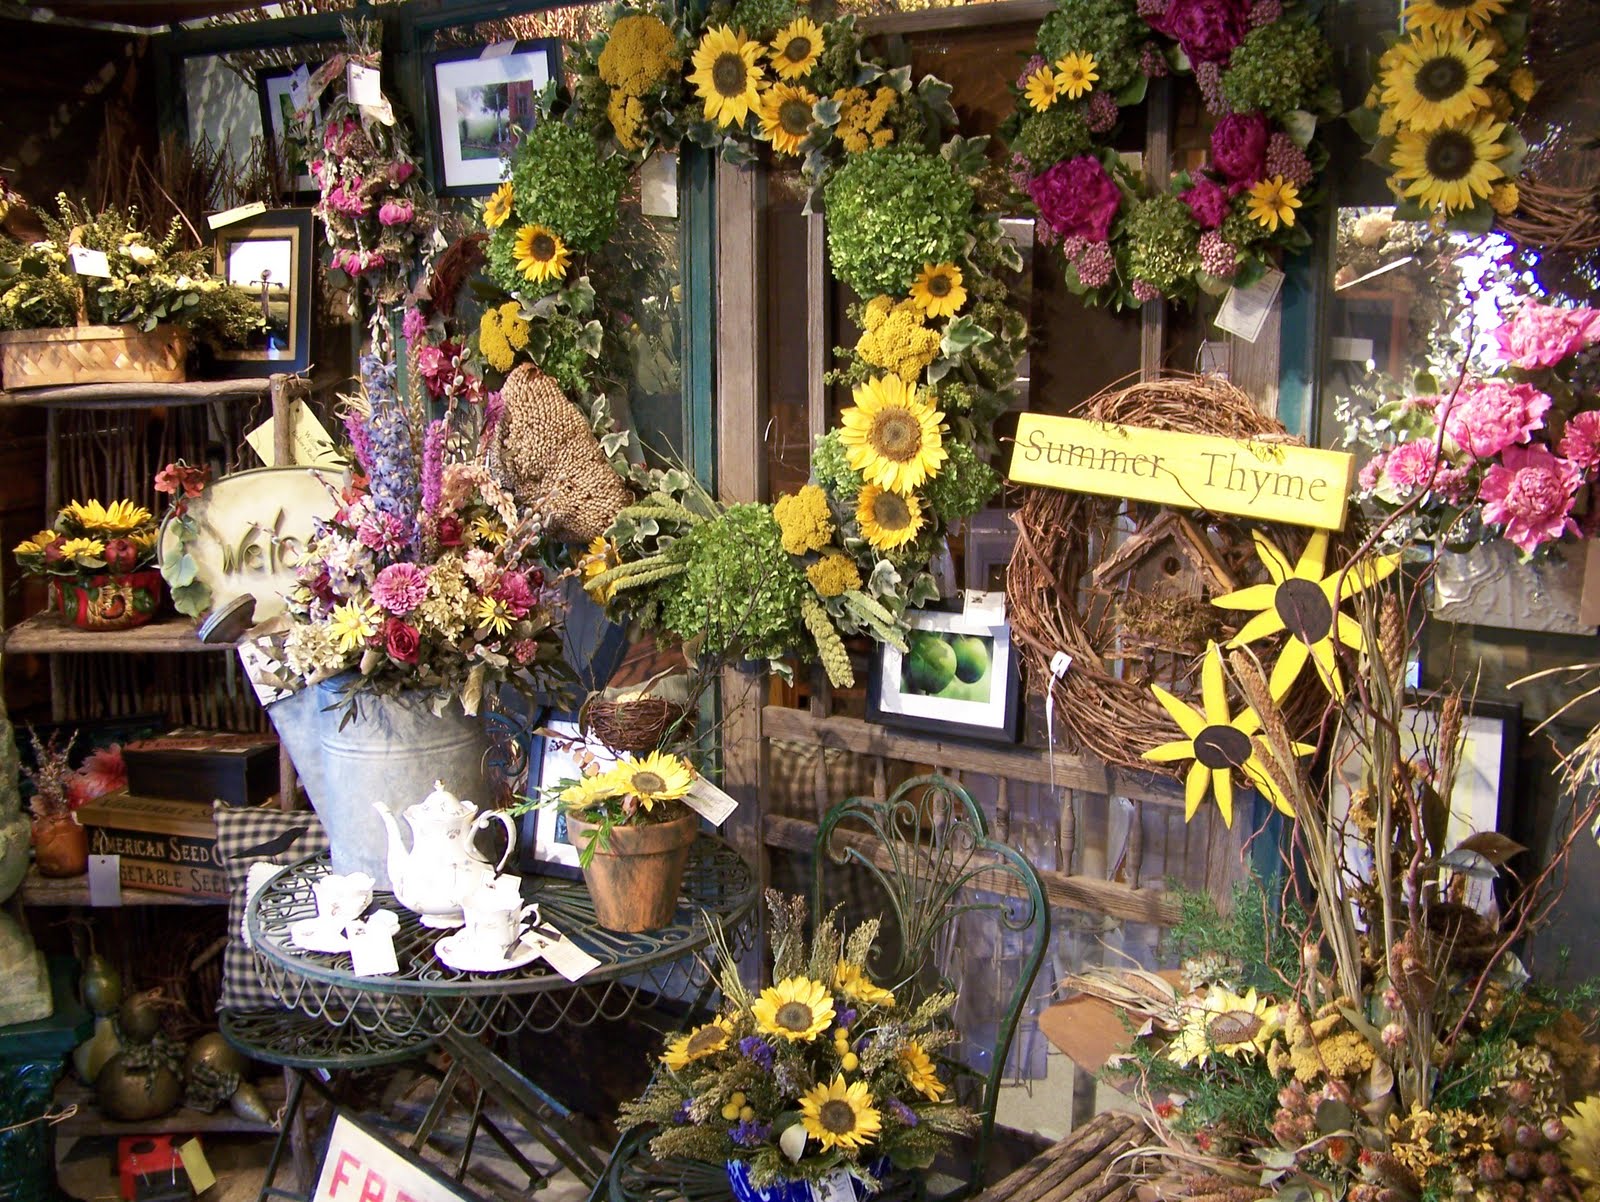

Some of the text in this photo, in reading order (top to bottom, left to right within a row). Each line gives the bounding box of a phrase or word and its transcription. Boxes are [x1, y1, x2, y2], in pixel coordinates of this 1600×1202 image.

[1024, 429, 1328, 505] Summer Thyme
[91, 829, 165, 858] AMERICAN
[169, 837, 209, 862] SEED
[120, 865, 183, 888] GETABLE
